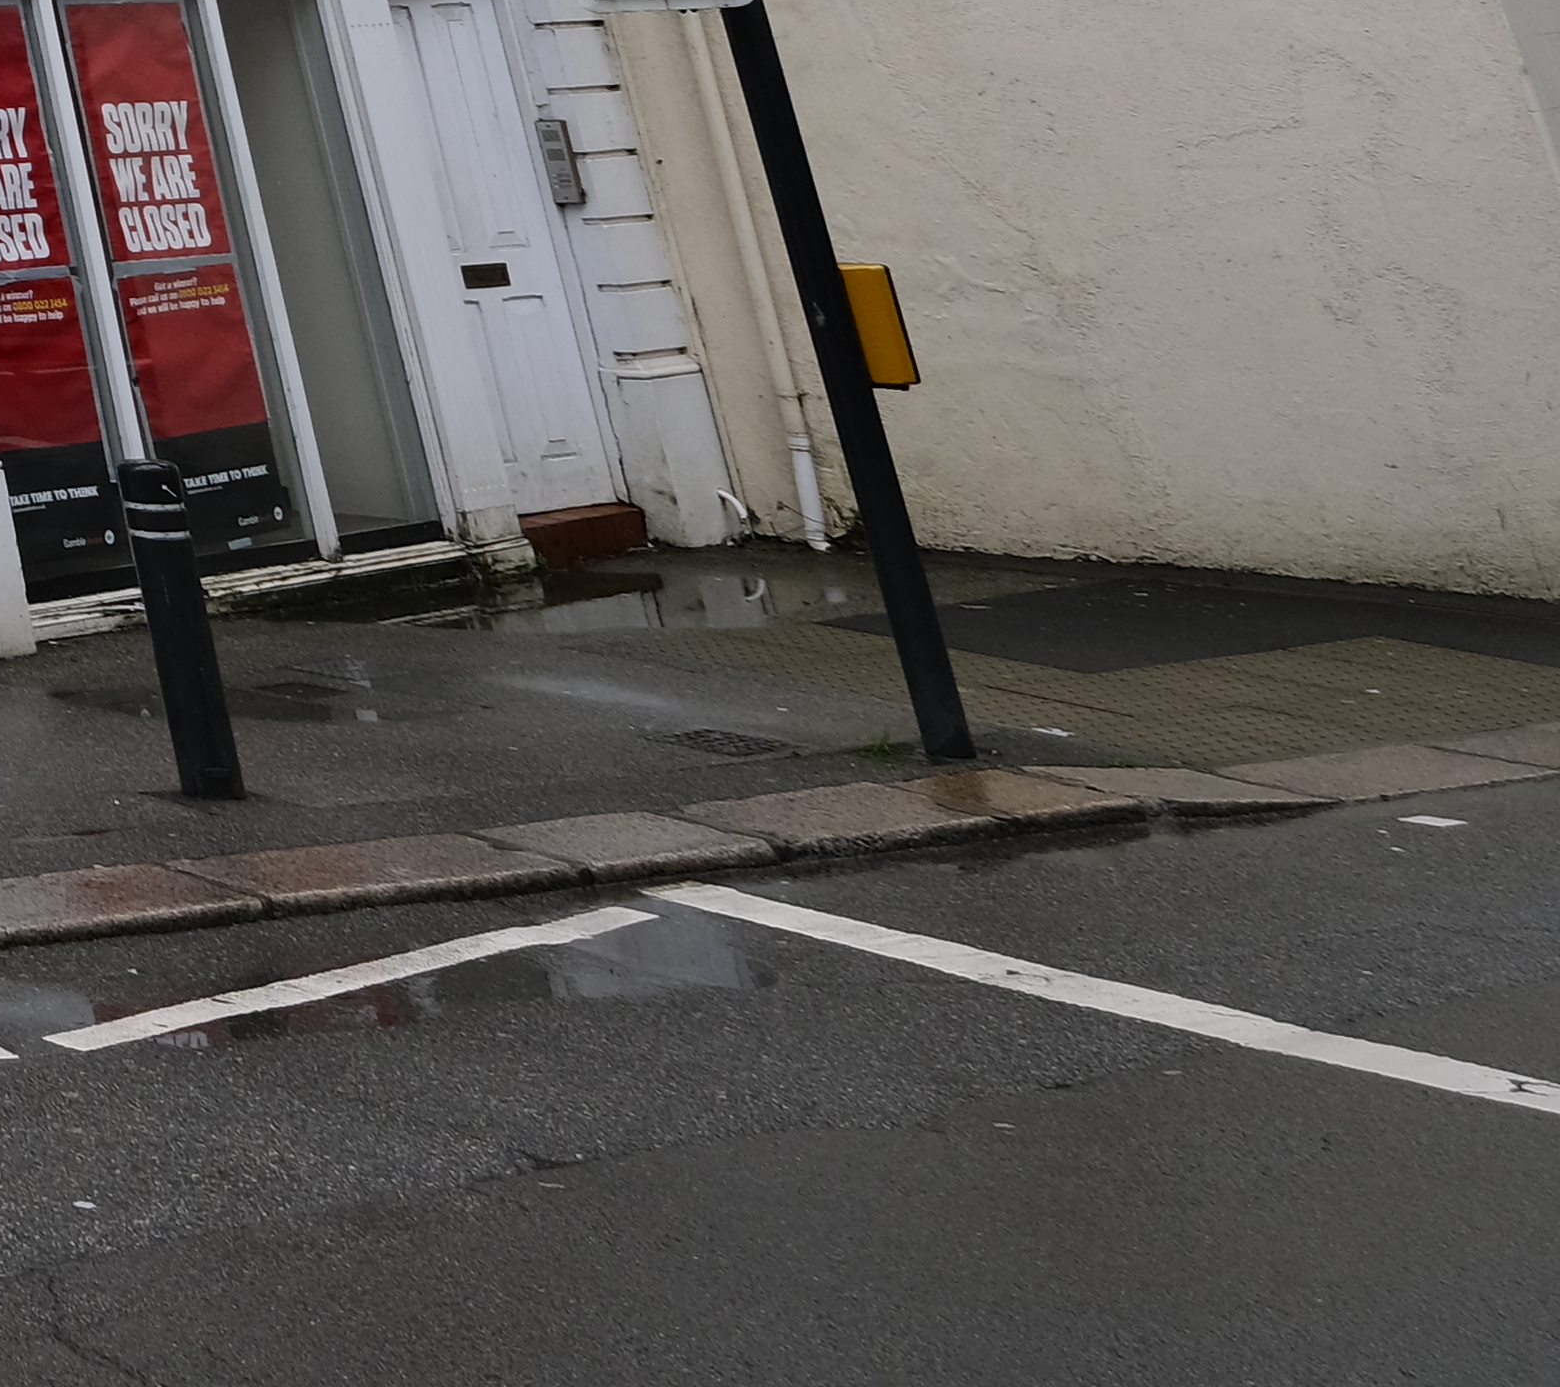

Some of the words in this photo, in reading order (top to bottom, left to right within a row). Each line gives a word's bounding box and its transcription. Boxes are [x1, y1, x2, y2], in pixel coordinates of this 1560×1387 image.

[101, 100, 188, 154] SORRY
[109, 157, 150, 202] WE
[150, 154, 200, 200] ARE
[118, 203, 212, 253] CLOSED
[9, 494, 31, 507] TAKE
[30, 490, 54, 503] TIME
[53, 488, 68, 501] TO
[66, 485, 99, 499] THINK
[183, 475, 208, 488] TAKE
[207, 471, 230, 485] TIME
[229, 469, 242, 481] TO
[241, 464, 269, 479] THINK
